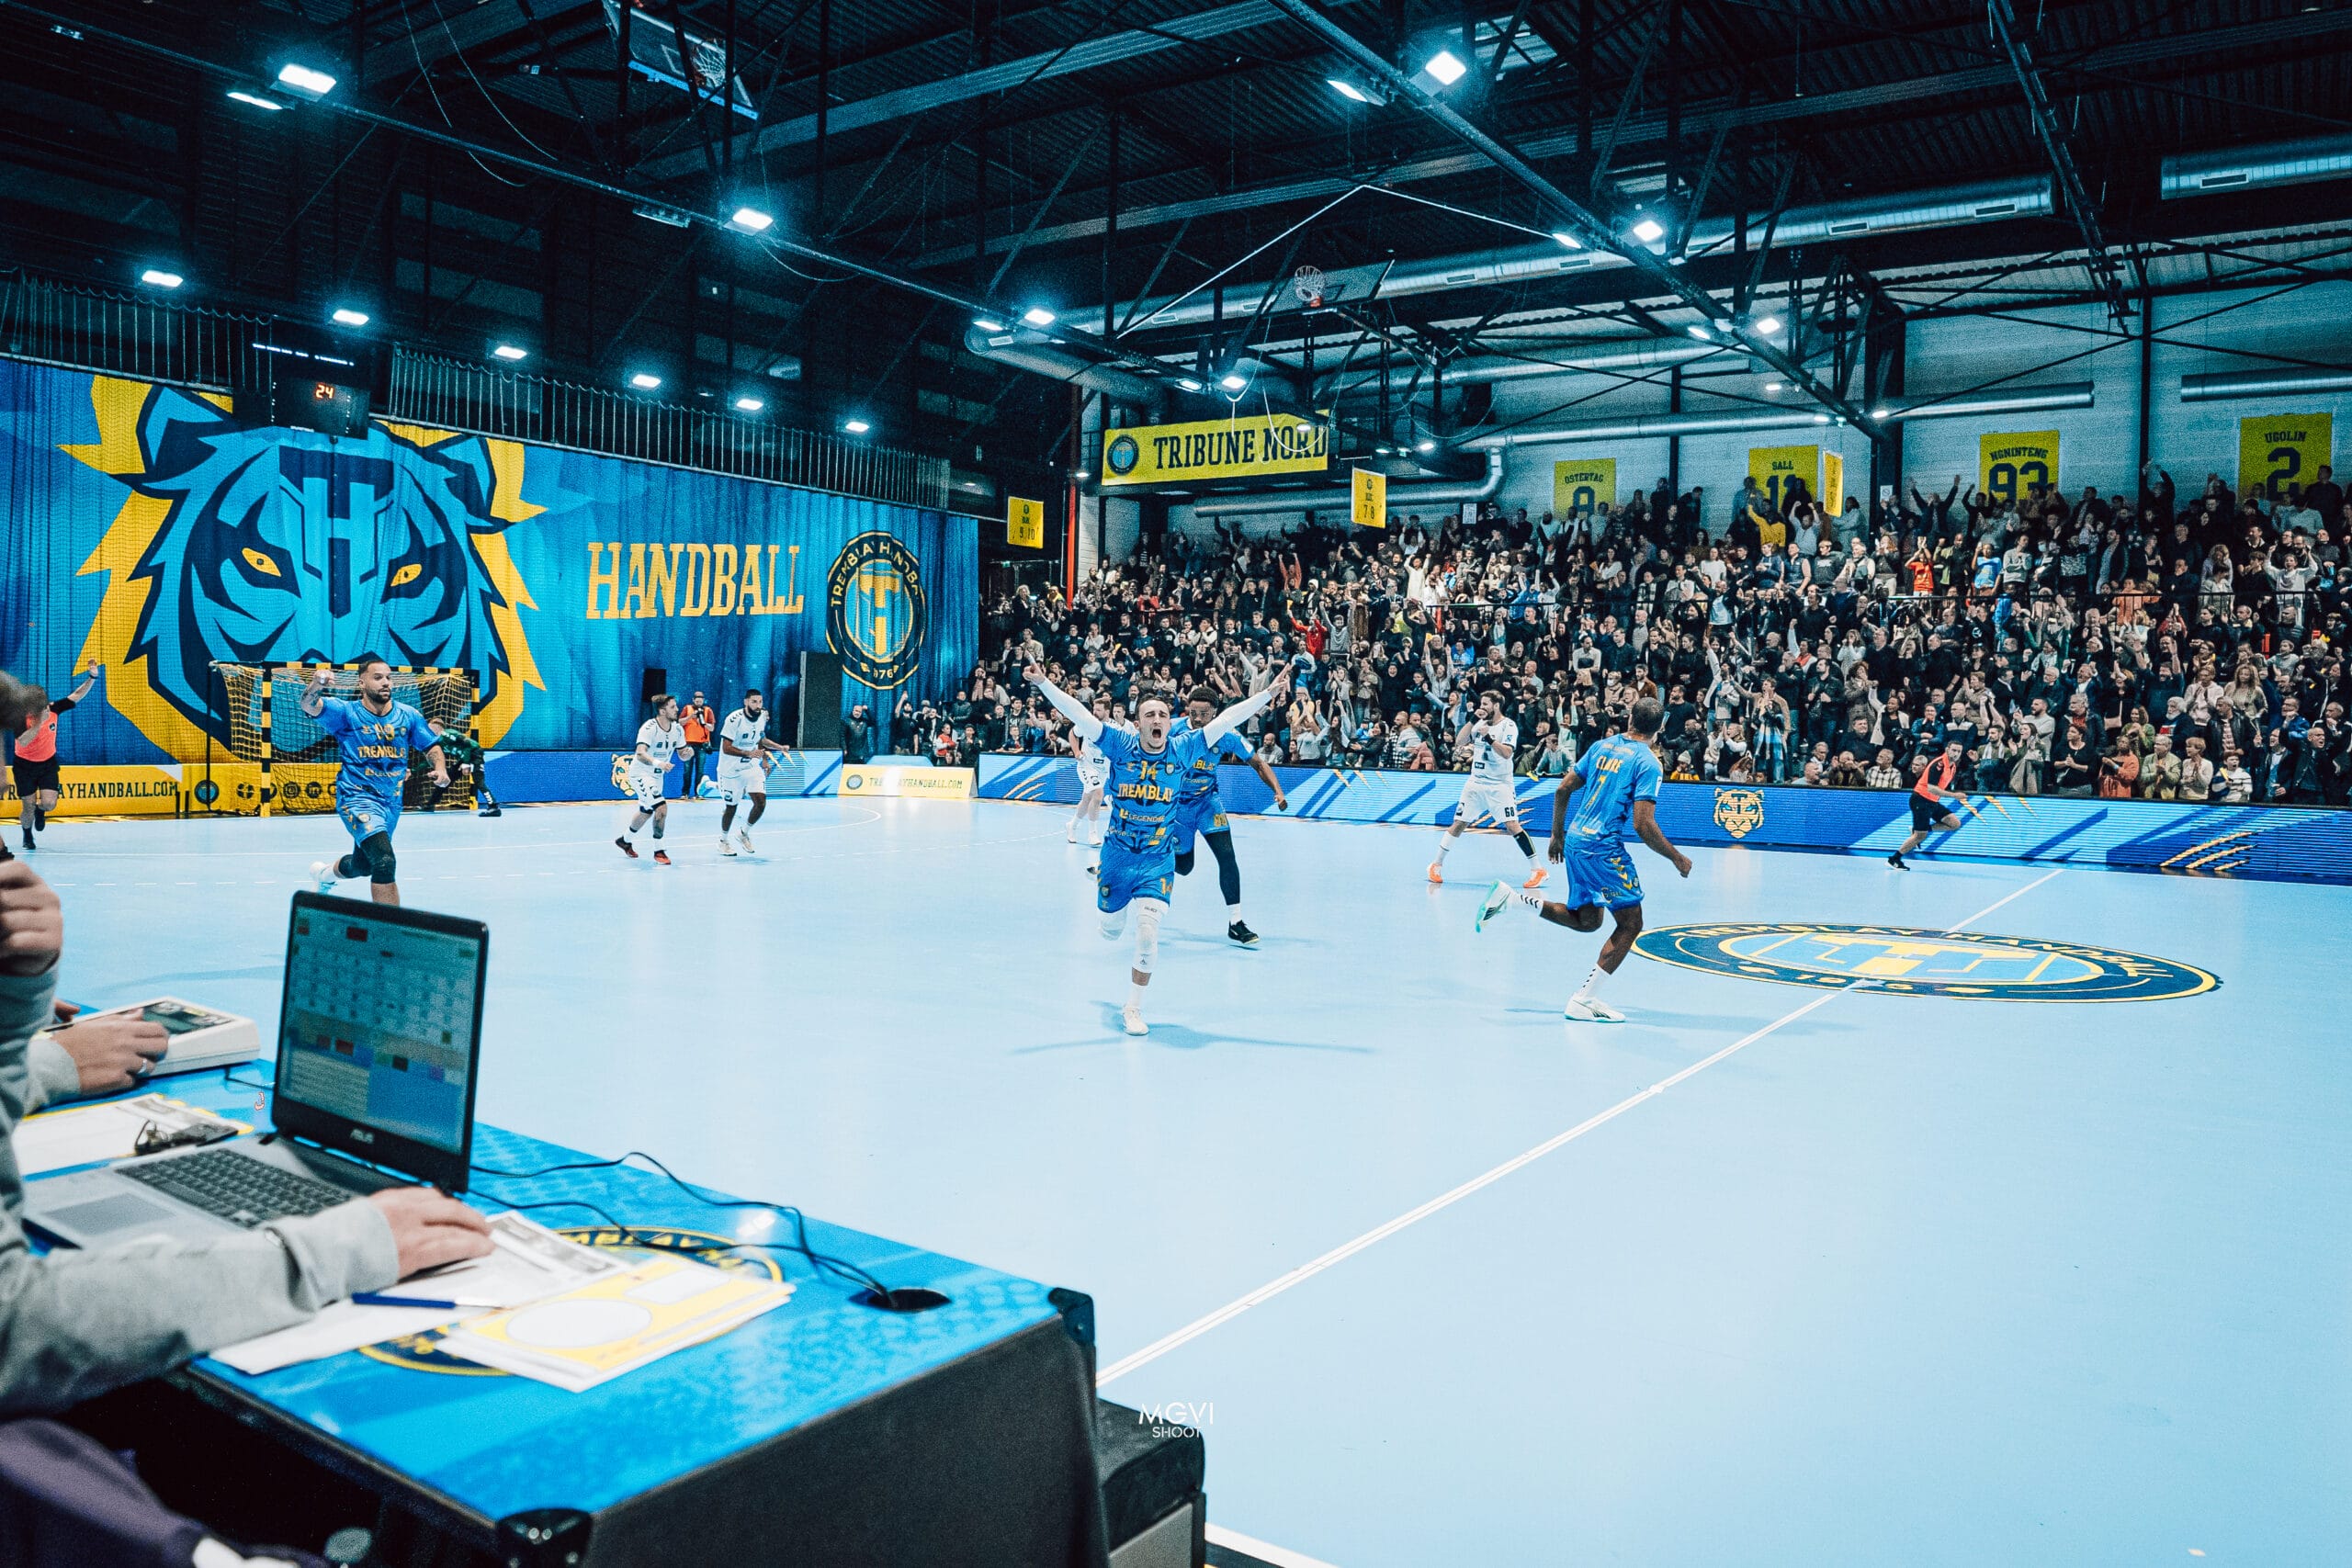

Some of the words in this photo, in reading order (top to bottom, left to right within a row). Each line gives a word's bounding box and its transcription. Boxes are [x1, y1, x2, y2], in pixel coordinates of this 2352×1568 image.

[315, 384, 334, 399] 24
[2265, 431, 2307, 443] UGOLIN
[1153, 429, 1255, 469] TRIBUNE
[1262, 423, 1328, 462] NORD
[1771, 460, 1793, 470] SALL
[1565, 472, 1604, 484] OSTERTAG
[2267, 447, 2301, 502] 2
[586, 542, 805, 619] HANDBALL
[1140, 760, 1159, 780] 14
[1504, 807, 1515, 818] 68
